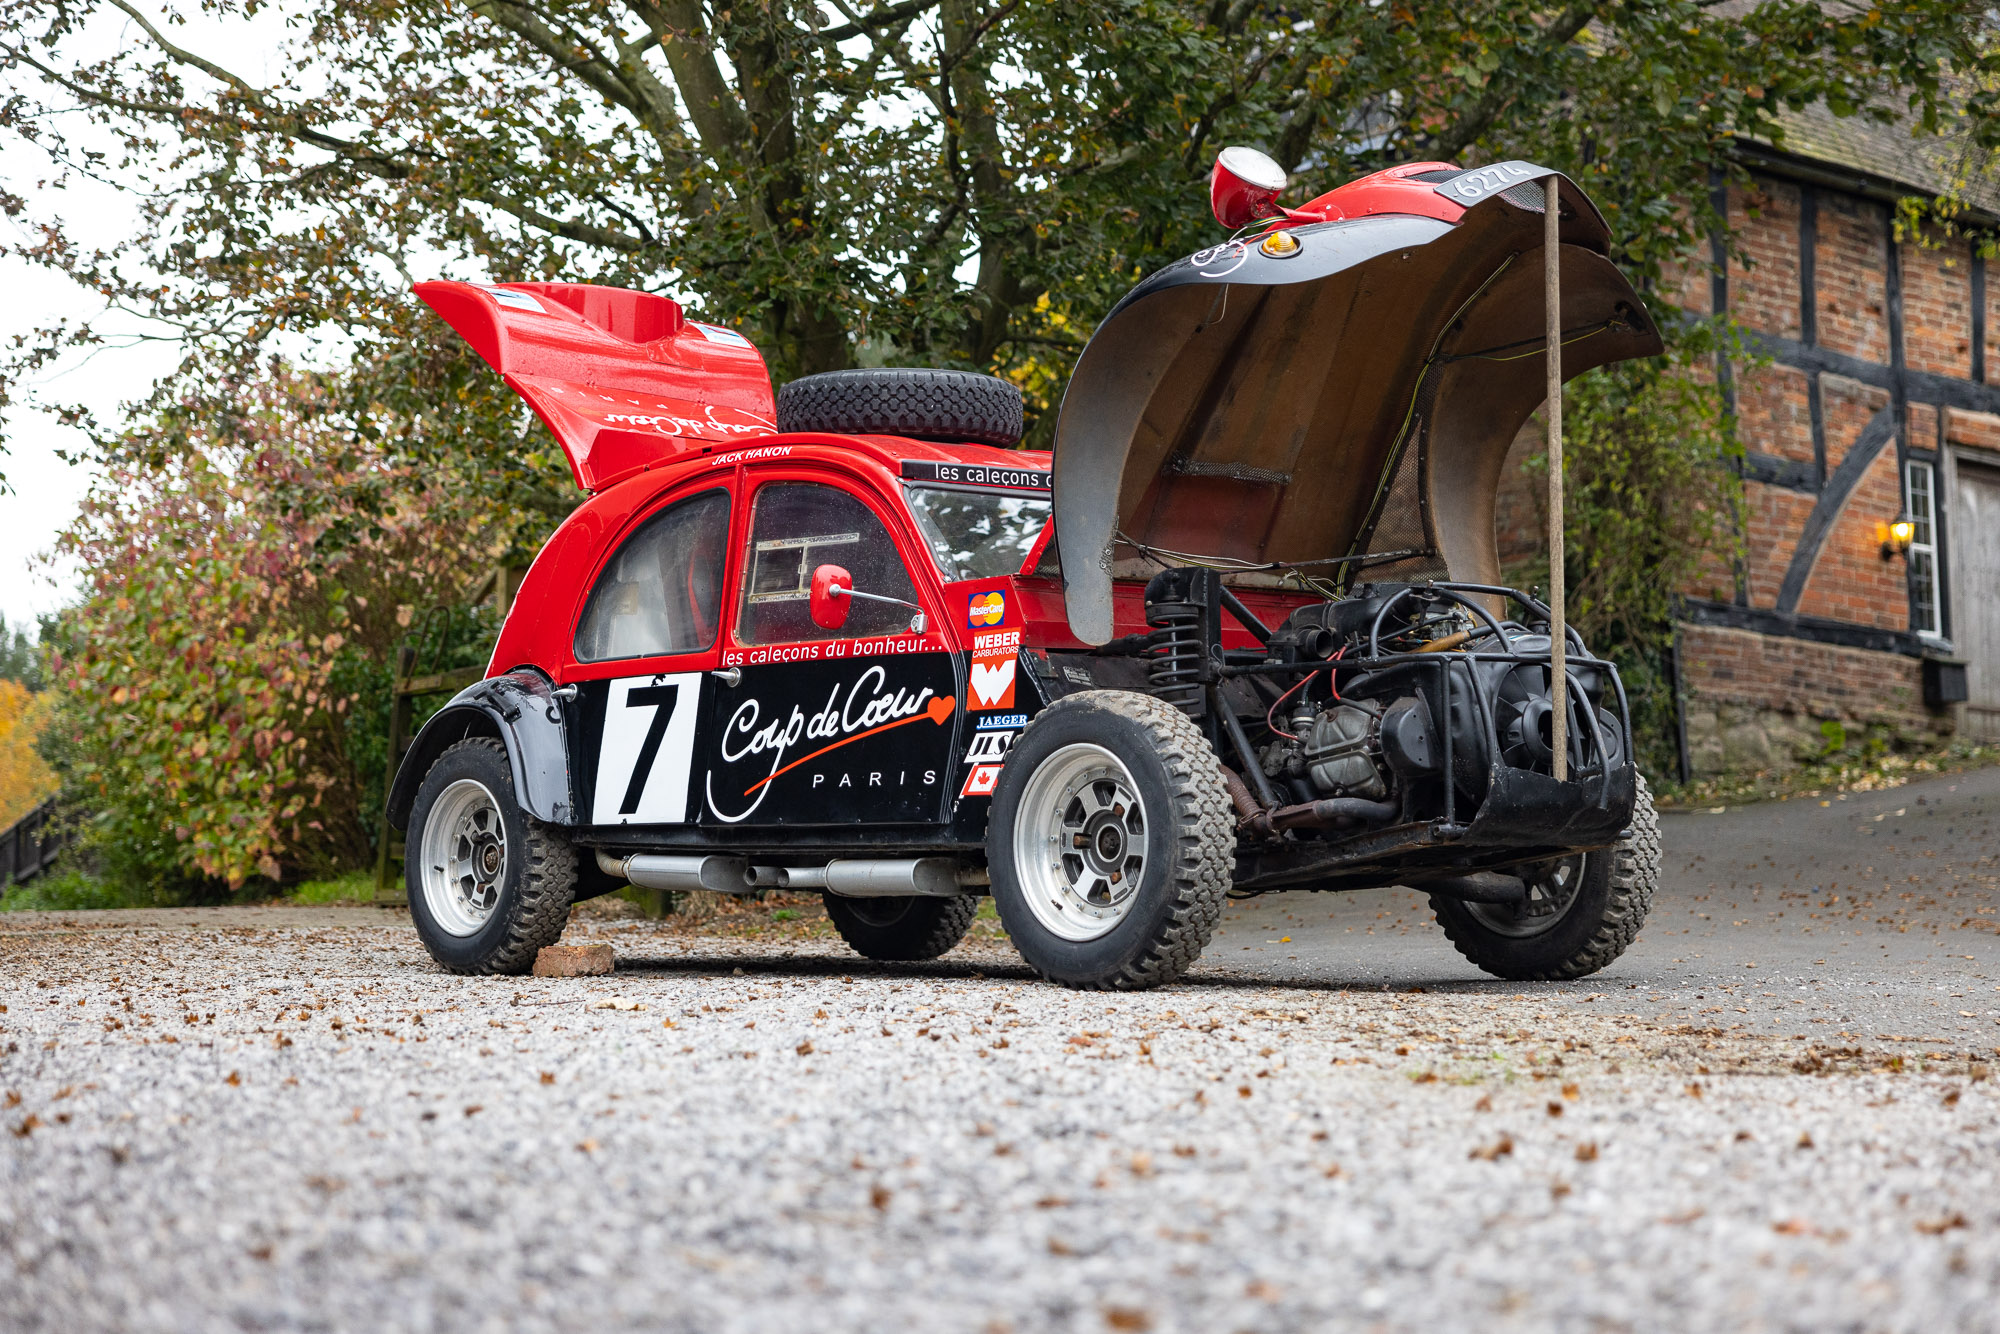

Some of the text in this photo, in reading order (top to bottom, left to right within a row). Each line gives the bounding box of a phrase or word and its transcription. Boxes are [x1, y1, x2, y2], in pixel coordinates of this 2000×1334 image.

[1453, 165, 1531, 198] 6274
[712, 446, 793, 466] JACK HANON
[935, 463, 960, 481] les
[966, 467, 1039, 487] caleçons
[969, 602, 1005, 617] MasterCard
[973, 631, 1020, 650] WEBER
[722, 637, 943, 666] les caleçons du bonheur...
[972, 645, 1019, 659] CARBURATORS
[976, 714, 1028, 730] JAEGER
[618, 683, 680, 815] 7
[706, 698, 805, 823] Coup
[806, 682, 840, 740] de
[968, 734, 1010, 757] JLS
[812, 770, 937, 789] PARIS
